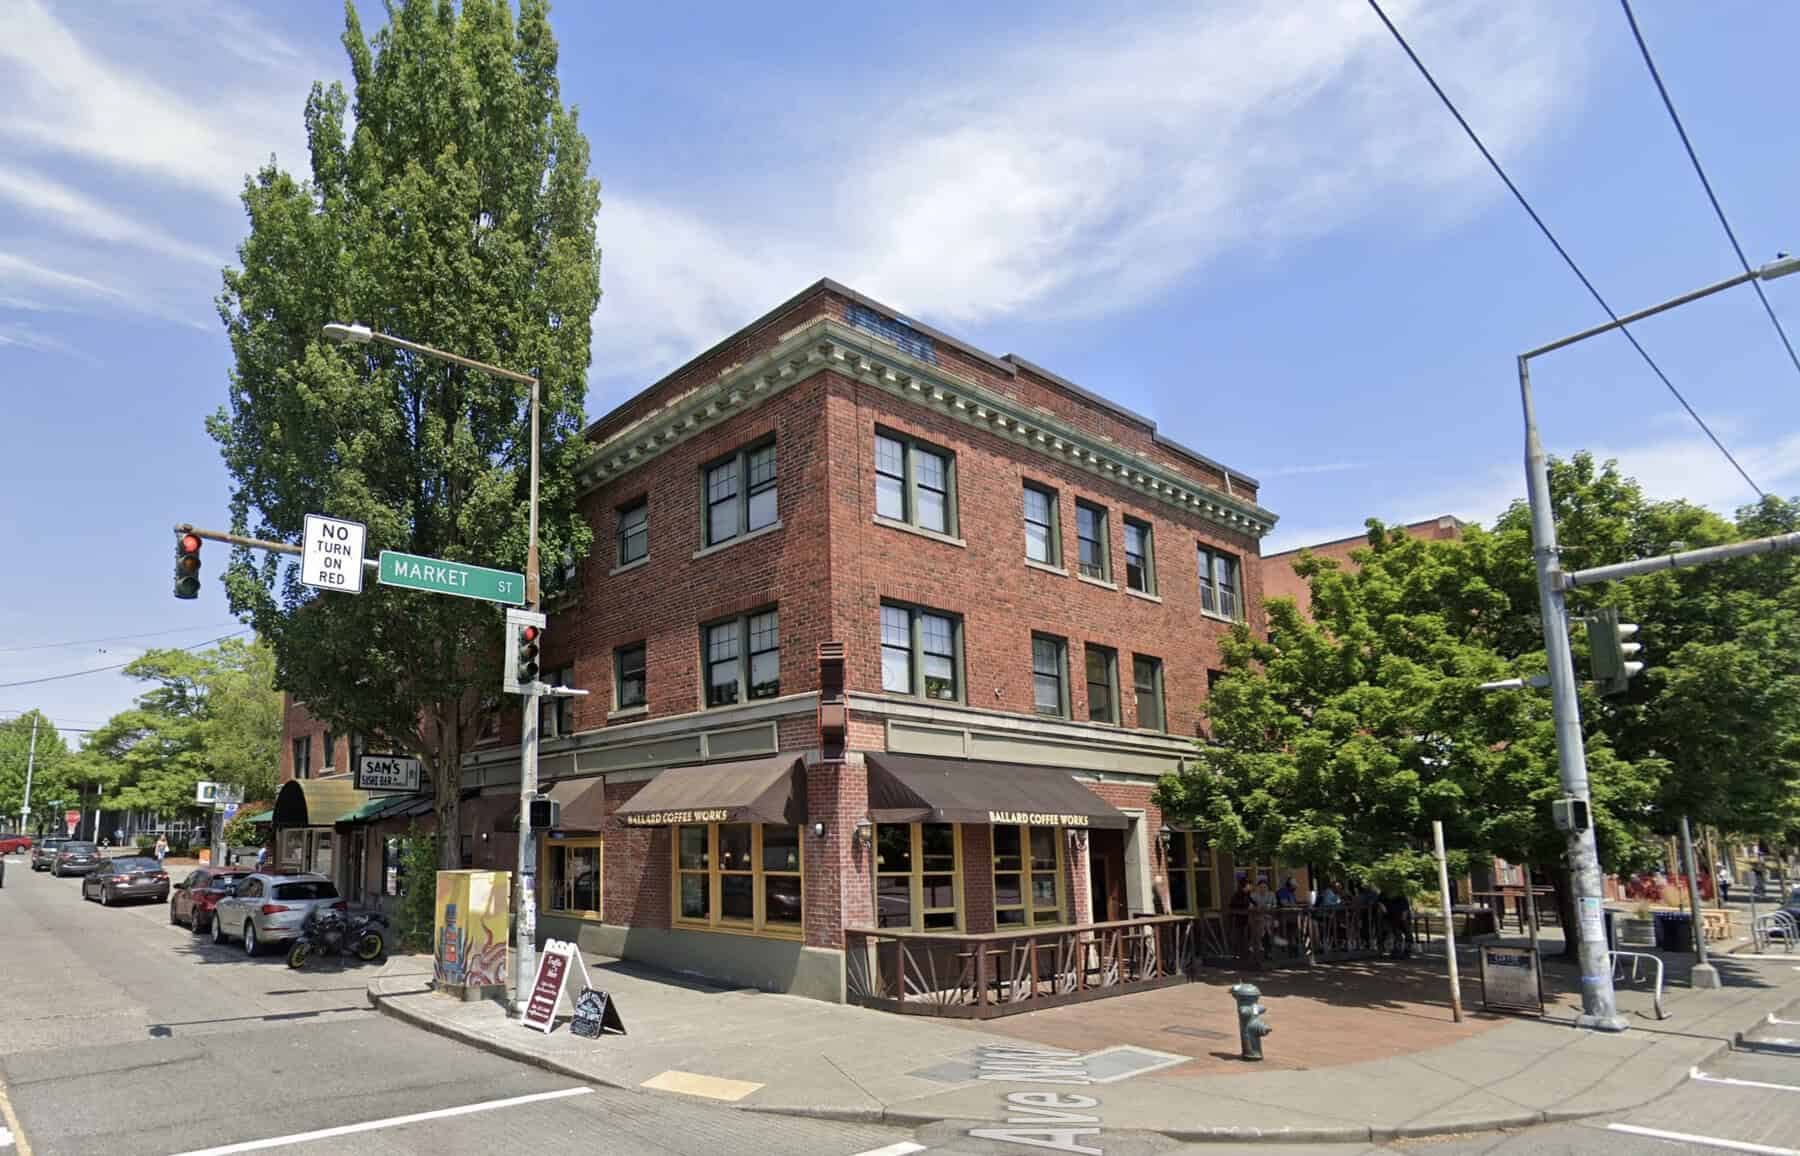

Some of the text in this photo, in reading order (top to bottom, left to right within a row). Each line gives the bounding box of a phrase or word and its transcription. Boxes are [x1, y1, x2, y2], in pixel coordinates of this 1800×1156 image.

[322, 523, 348, 541] NO
[317, 540, 351, 556] TURN
[324, 556, 342, 570] ON
[319, 571, 345, 585] RED
[394, 559, 513, 593] MARKET ST
[366, 760, 400, 775] SAM'S
[627, 809, 728, 825] BALLARD COFFEE WORKS
[988, 810, 1089, 826] BALLARD COFFEE WORKS
